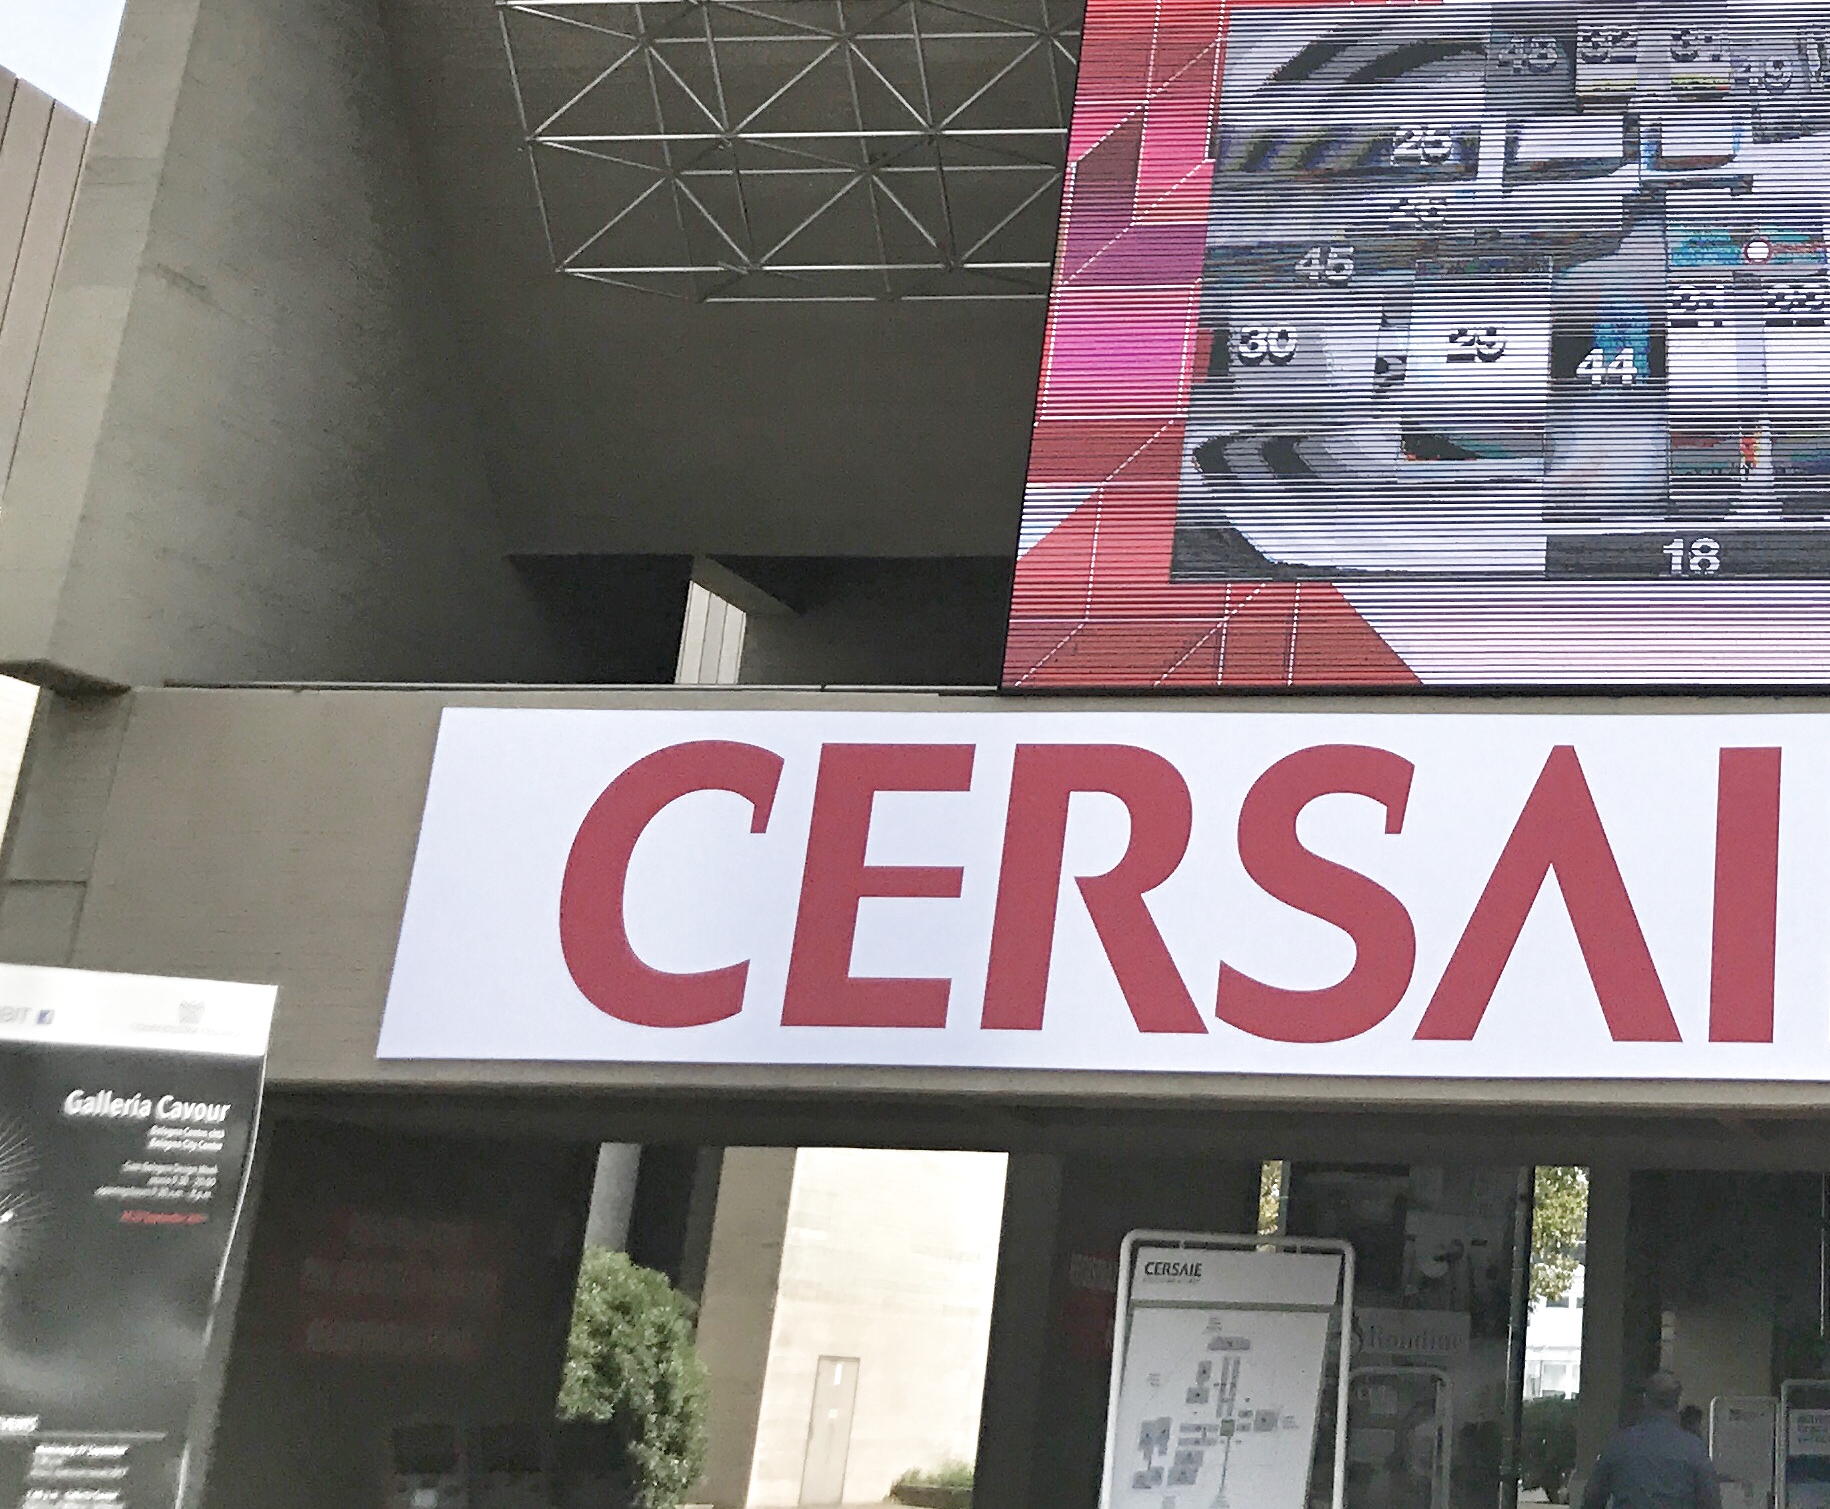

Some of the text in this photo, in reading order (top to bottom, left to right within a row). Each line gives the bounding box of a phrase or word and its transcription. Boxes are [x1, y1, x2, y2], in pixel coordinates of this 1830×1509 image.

[1294, 246, 1354, 287] 45
[1236, 323, 1298, 366] 30
[1575, 347, 1639, 386] 44
[1663, 537, 1722, 575] 18
[64, 1089, 231, 1123] Galleria Cavour
[1144, 1260, 1202, 1278] CERSAIE
